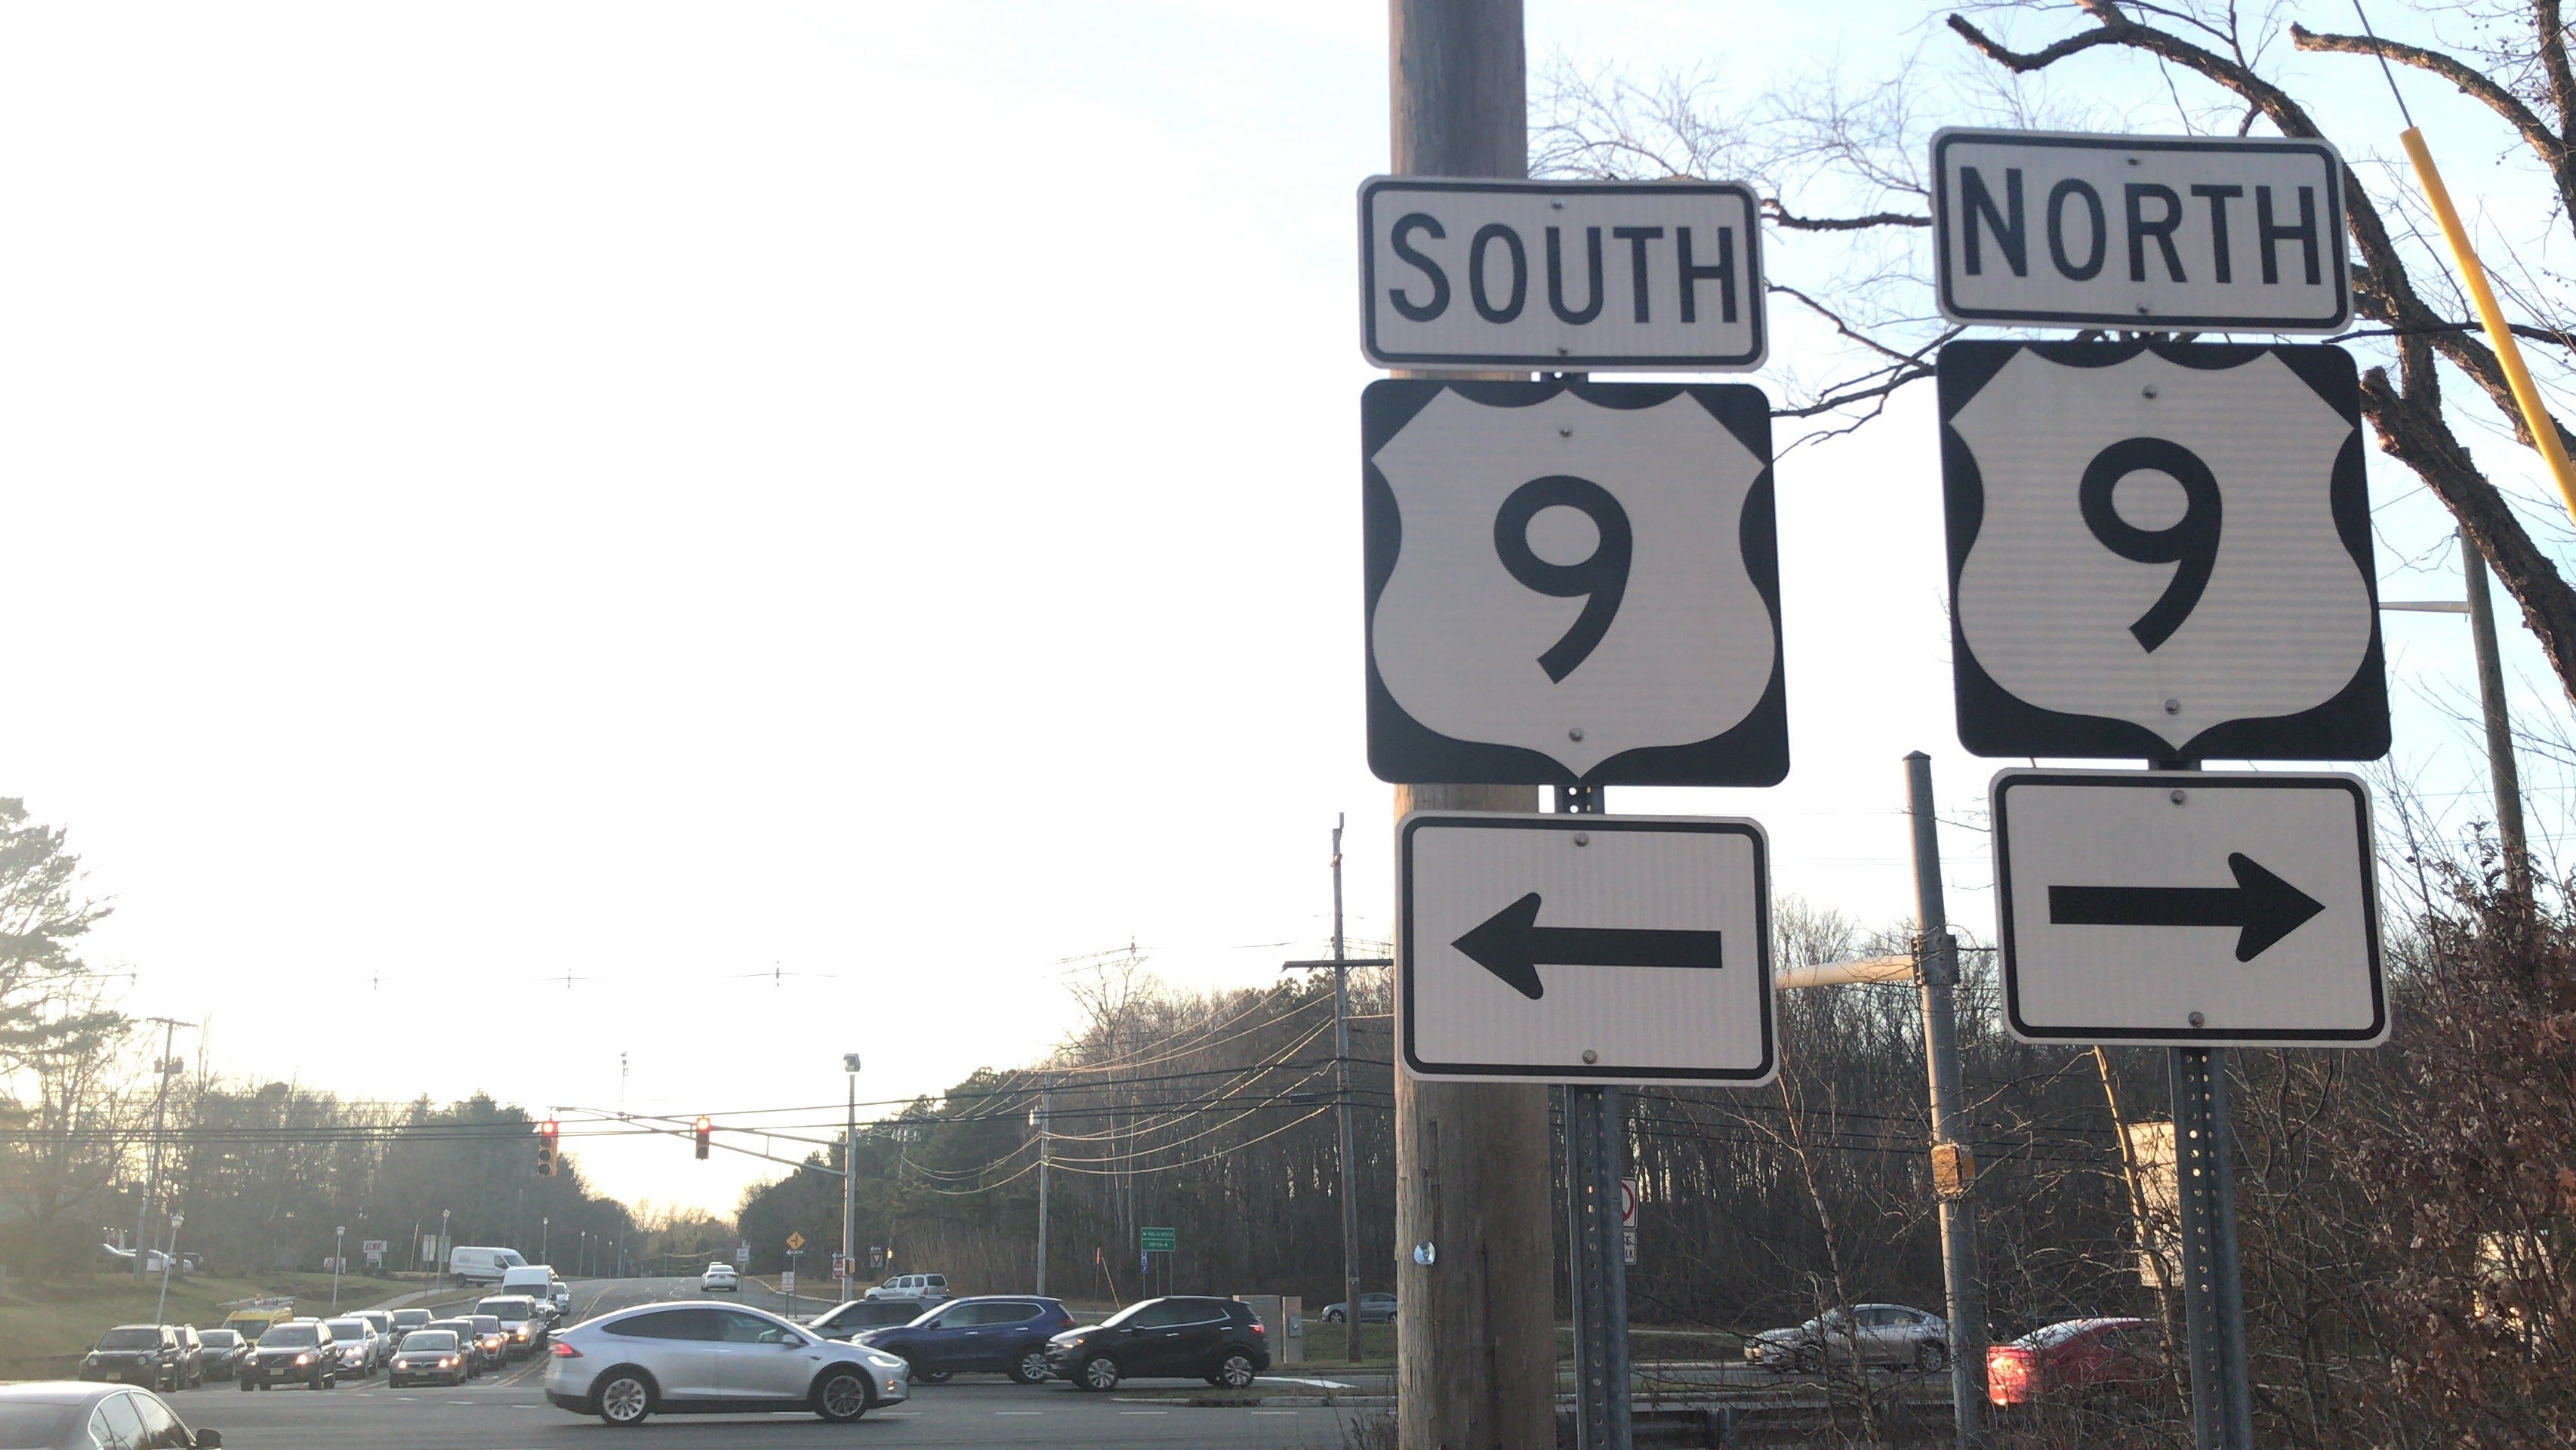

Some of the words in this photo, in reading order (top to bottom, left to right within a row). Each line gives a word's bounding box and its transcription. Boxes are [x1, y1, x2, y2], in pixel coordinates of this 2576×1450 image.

[1388, 212, 1739, 326] SOUTH
[1959, 165, 2322, 286] NORTH
[1494, 475, 1634, 684] 9
[2078, 437, 2223, 654] 9
